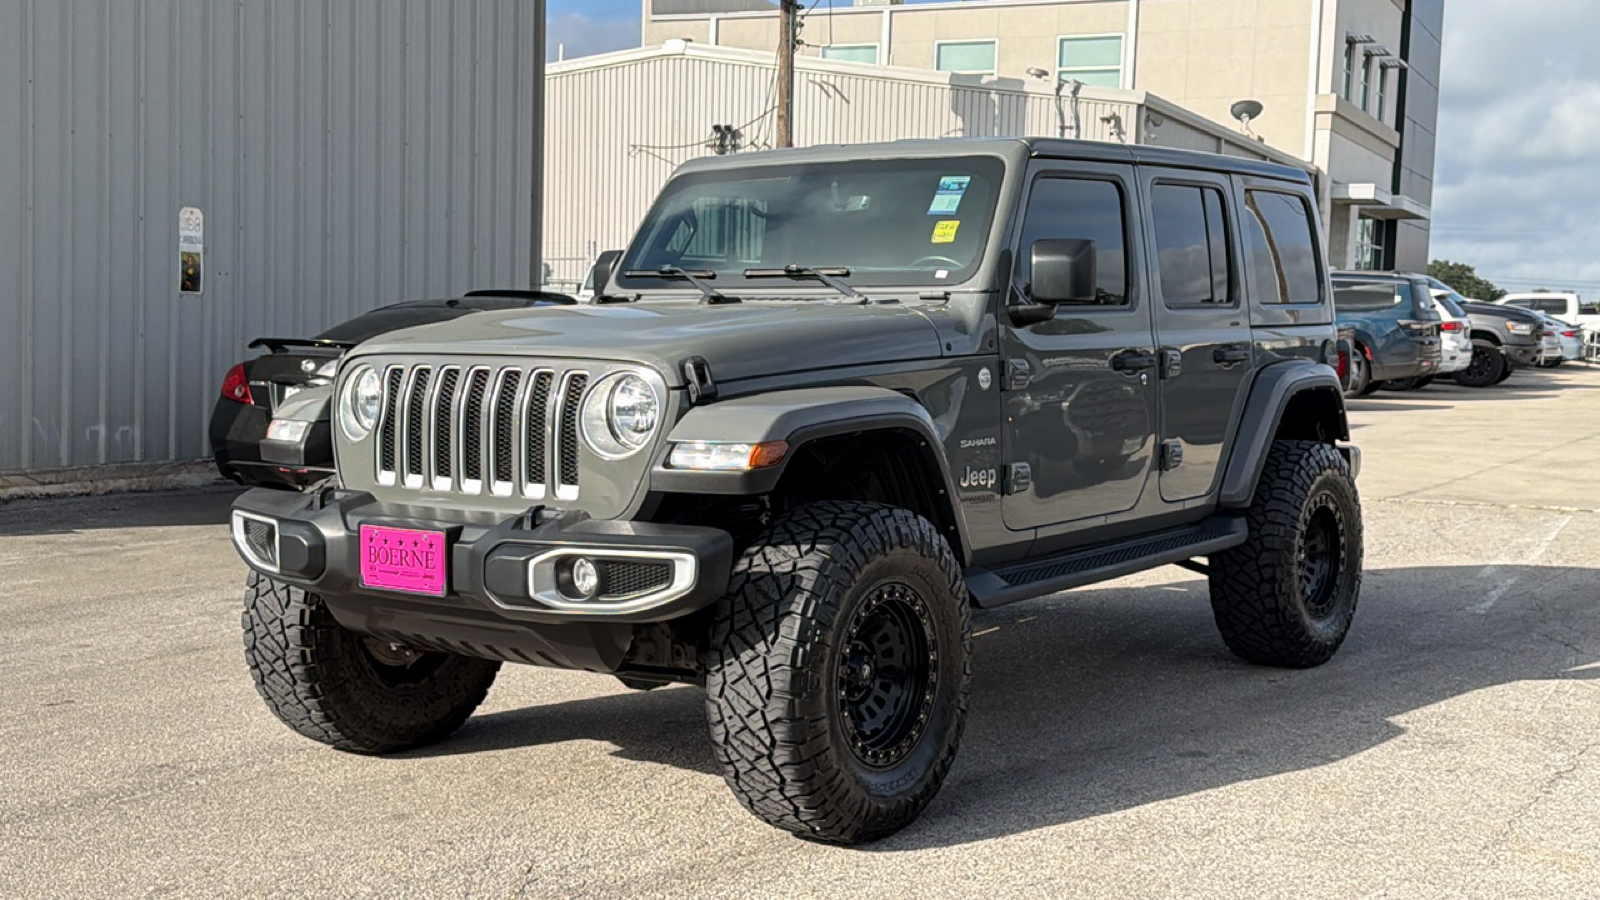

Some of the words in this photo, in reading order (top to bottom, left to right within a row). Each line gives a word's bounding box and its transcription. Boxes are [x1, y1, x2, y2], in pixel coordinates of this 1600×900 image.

[960, 437, 996, 448] SAHARA
[960, 466, 996, 488] Jeep
[368, 545, 436, 570] BOERNE
